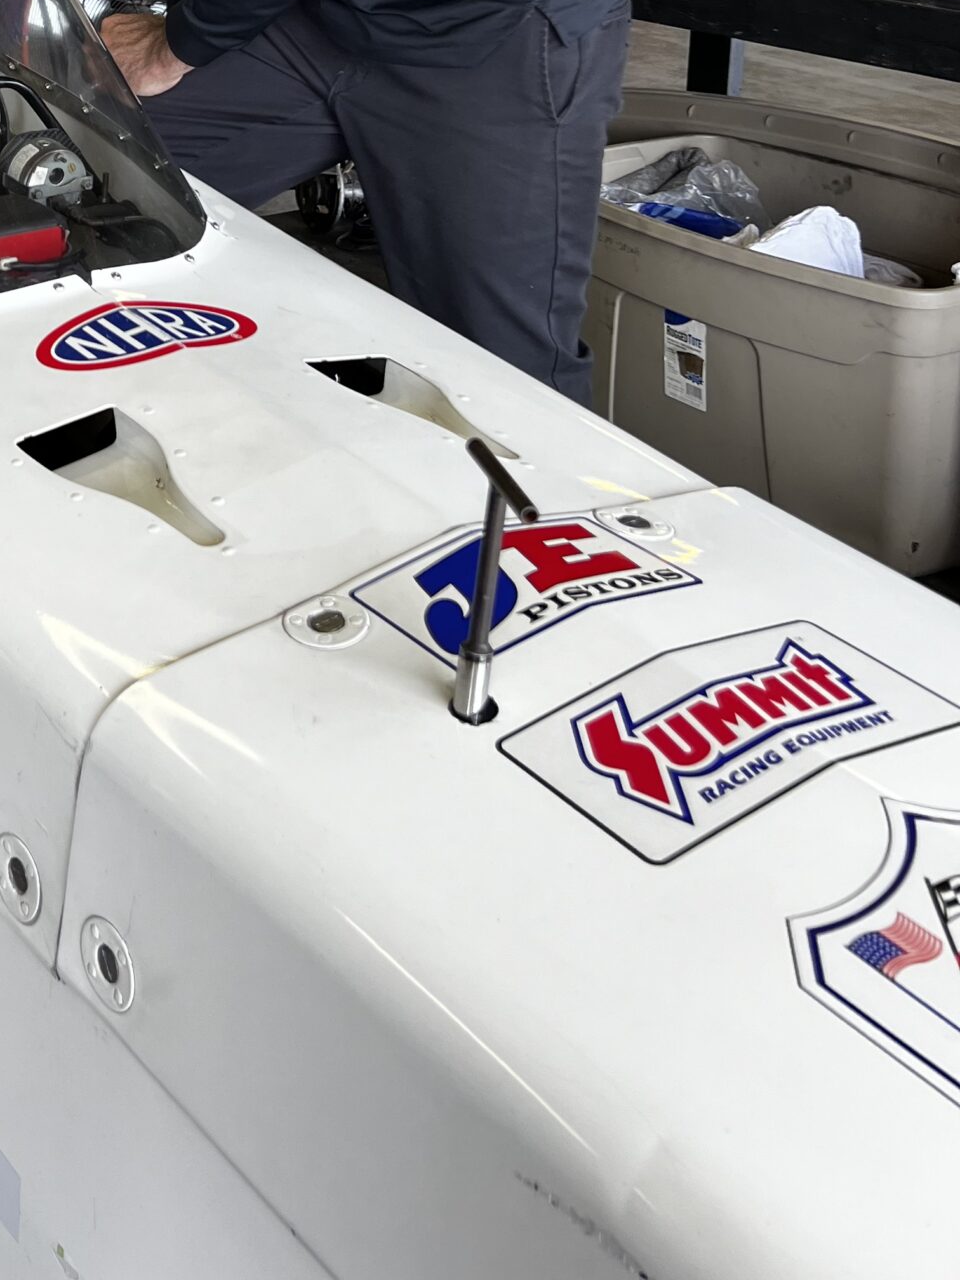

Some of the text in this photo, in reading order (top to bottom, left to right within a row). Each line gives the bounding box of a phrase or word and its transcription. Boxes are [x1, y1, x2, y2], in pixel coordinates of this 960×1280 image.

[64, 308, 228, 360] NHRA
[413, 523, 643, 656] JE
[517, 567, 684, 623] PISTONS
[697, 710, 895, 804] RACING EQUIPMENT
